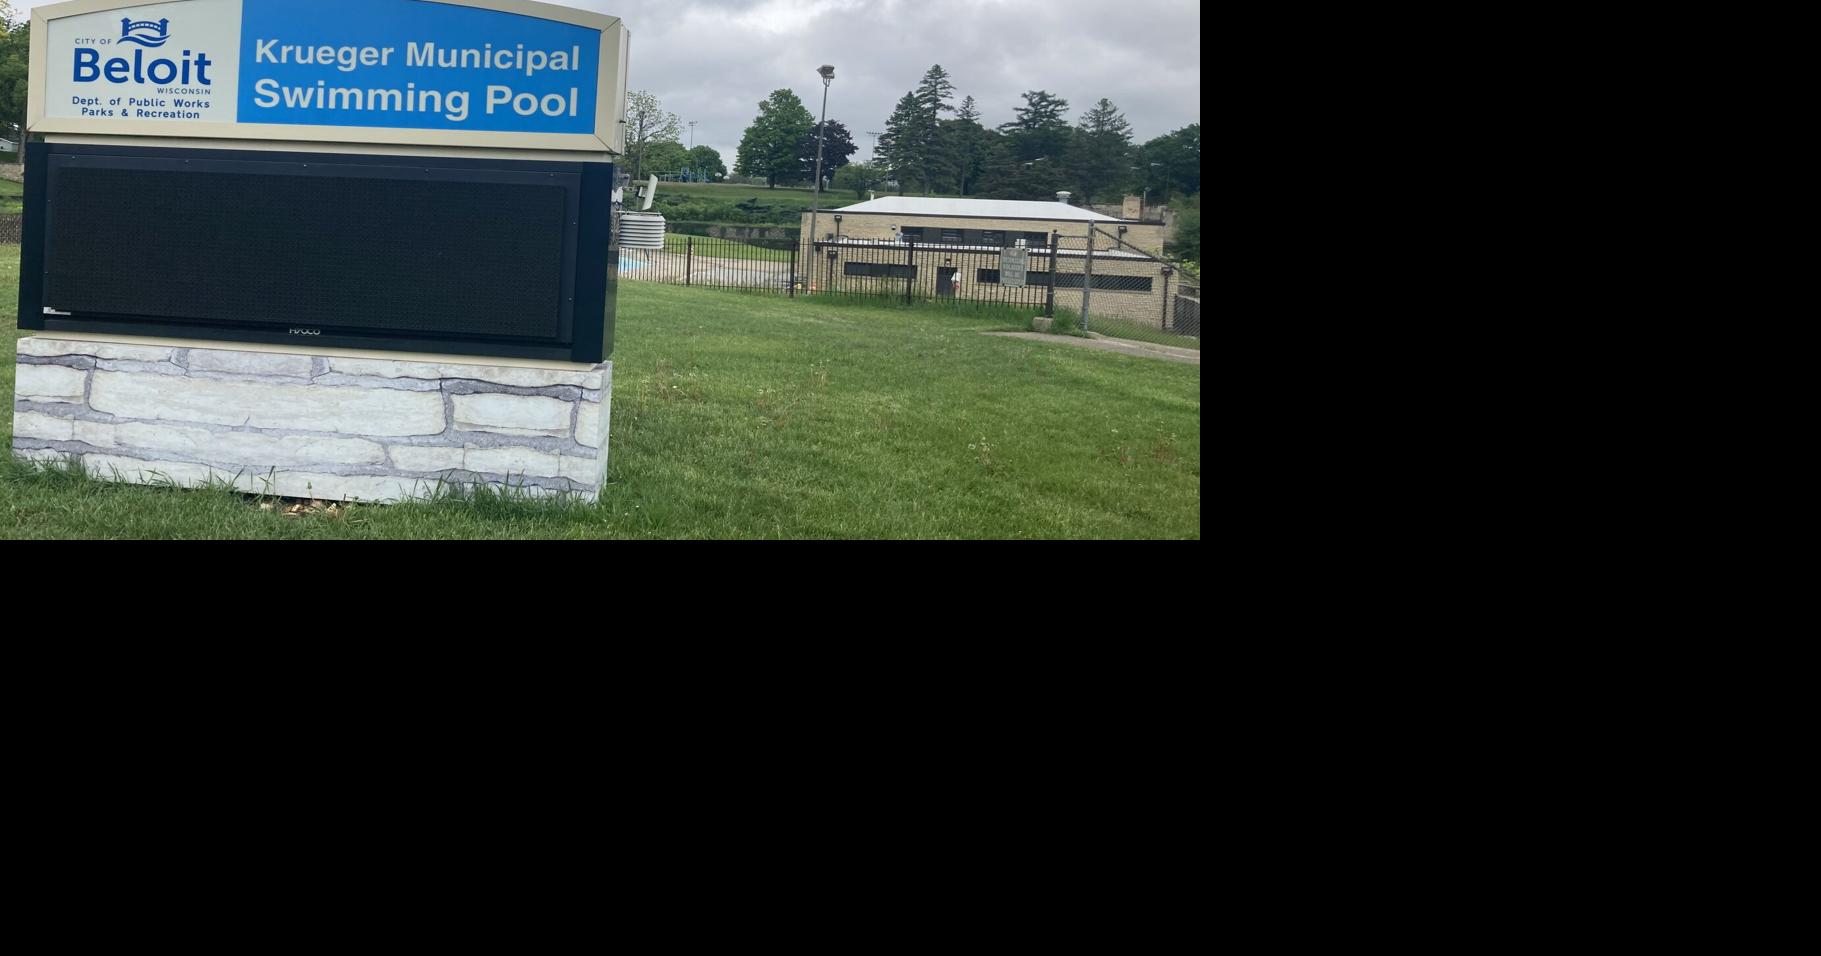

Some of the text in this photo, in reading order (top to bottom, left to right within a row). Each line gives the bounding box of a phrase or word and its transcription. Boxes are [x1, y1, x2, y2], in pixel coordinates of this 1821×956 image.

[73, 48, 212, 85] Beloit
[255, 38, 579, 77] Krueger Municipal
[72, 96, 210, 108] Dept. of Public Works
[157, 87, 211, 95] WISCONSIN
[253, 78, 578, 121] Swimming Pool
[81, 107, 200, 119] Parks & Recreation
